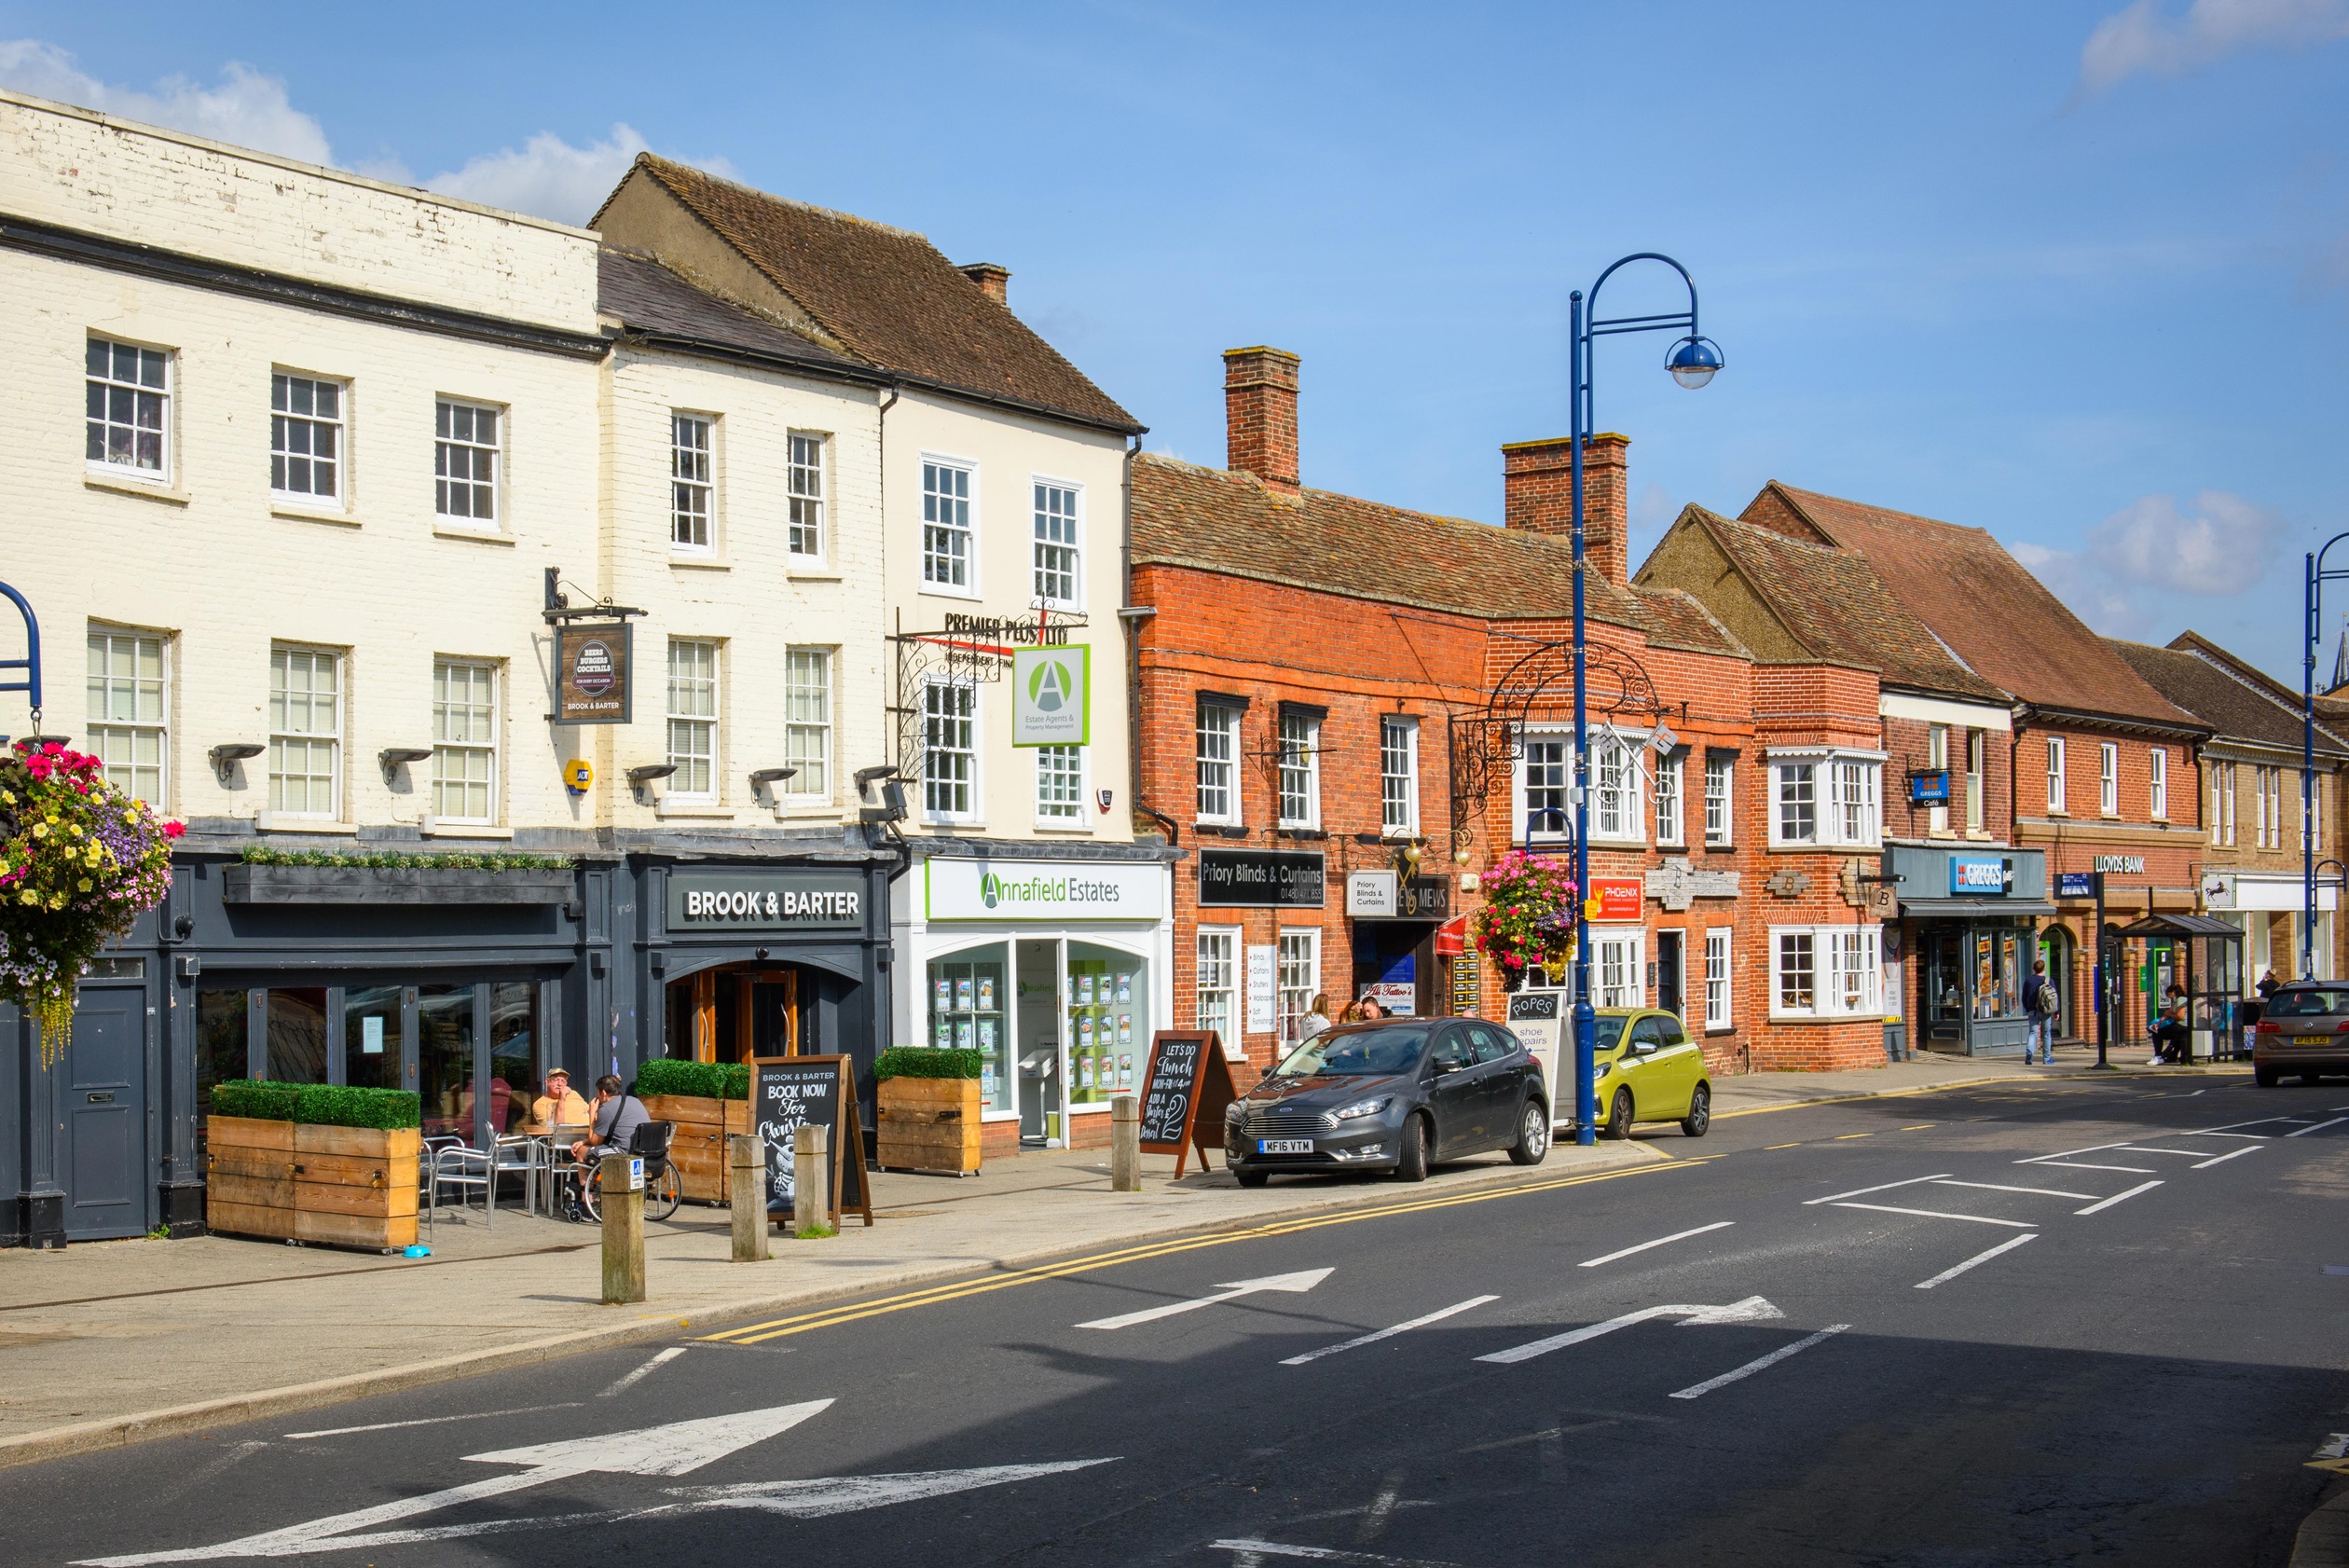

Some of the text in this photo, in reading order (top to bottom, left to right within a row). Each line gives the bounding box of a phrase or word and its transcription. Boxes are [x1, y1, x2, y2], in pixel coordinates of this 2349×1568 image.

[945, 612, 1000, 638] PREMIER
[1006, 620, 1037, 644] PLUS
[580, 656, 608, 665] BURGERS
[1045, 714, 1067, 723] Agents
[1923, 799, 1940, 807] Café
[2095, 855, 2145, 873] LLOYDS BANK
[1202, 862, 1322, 887] Priory Blinds & Curtains
[1967, 863, 2001, 886] GREGGS
[981, 872, 1120, 909] Annafield Estates
[1311, 888, 1322, 900] 855
[1396, 887, 1446, 908] EYS MEWS
[1604, 887, 1639, 898] PHOENIX
[686, 890, 859, 916] BROOK & BARTER
[1520, 1038, 1547, 1046] epairs
[1166, 1043, 1196, 1056] LET'S DO
[1156, 1055, 1194, 1078] Lunch
[762, 1073, 792, 1081] BROOK
[802, 1072, 835, 1080] BARTER
[768, 1083, 827, 1099] BOOK NOW
[1147, 1093, 1166, 1105] ADD A
[778, 1097, 807, 1117] For
[1266, 1141, 1310, 1151] MF16 VTM
